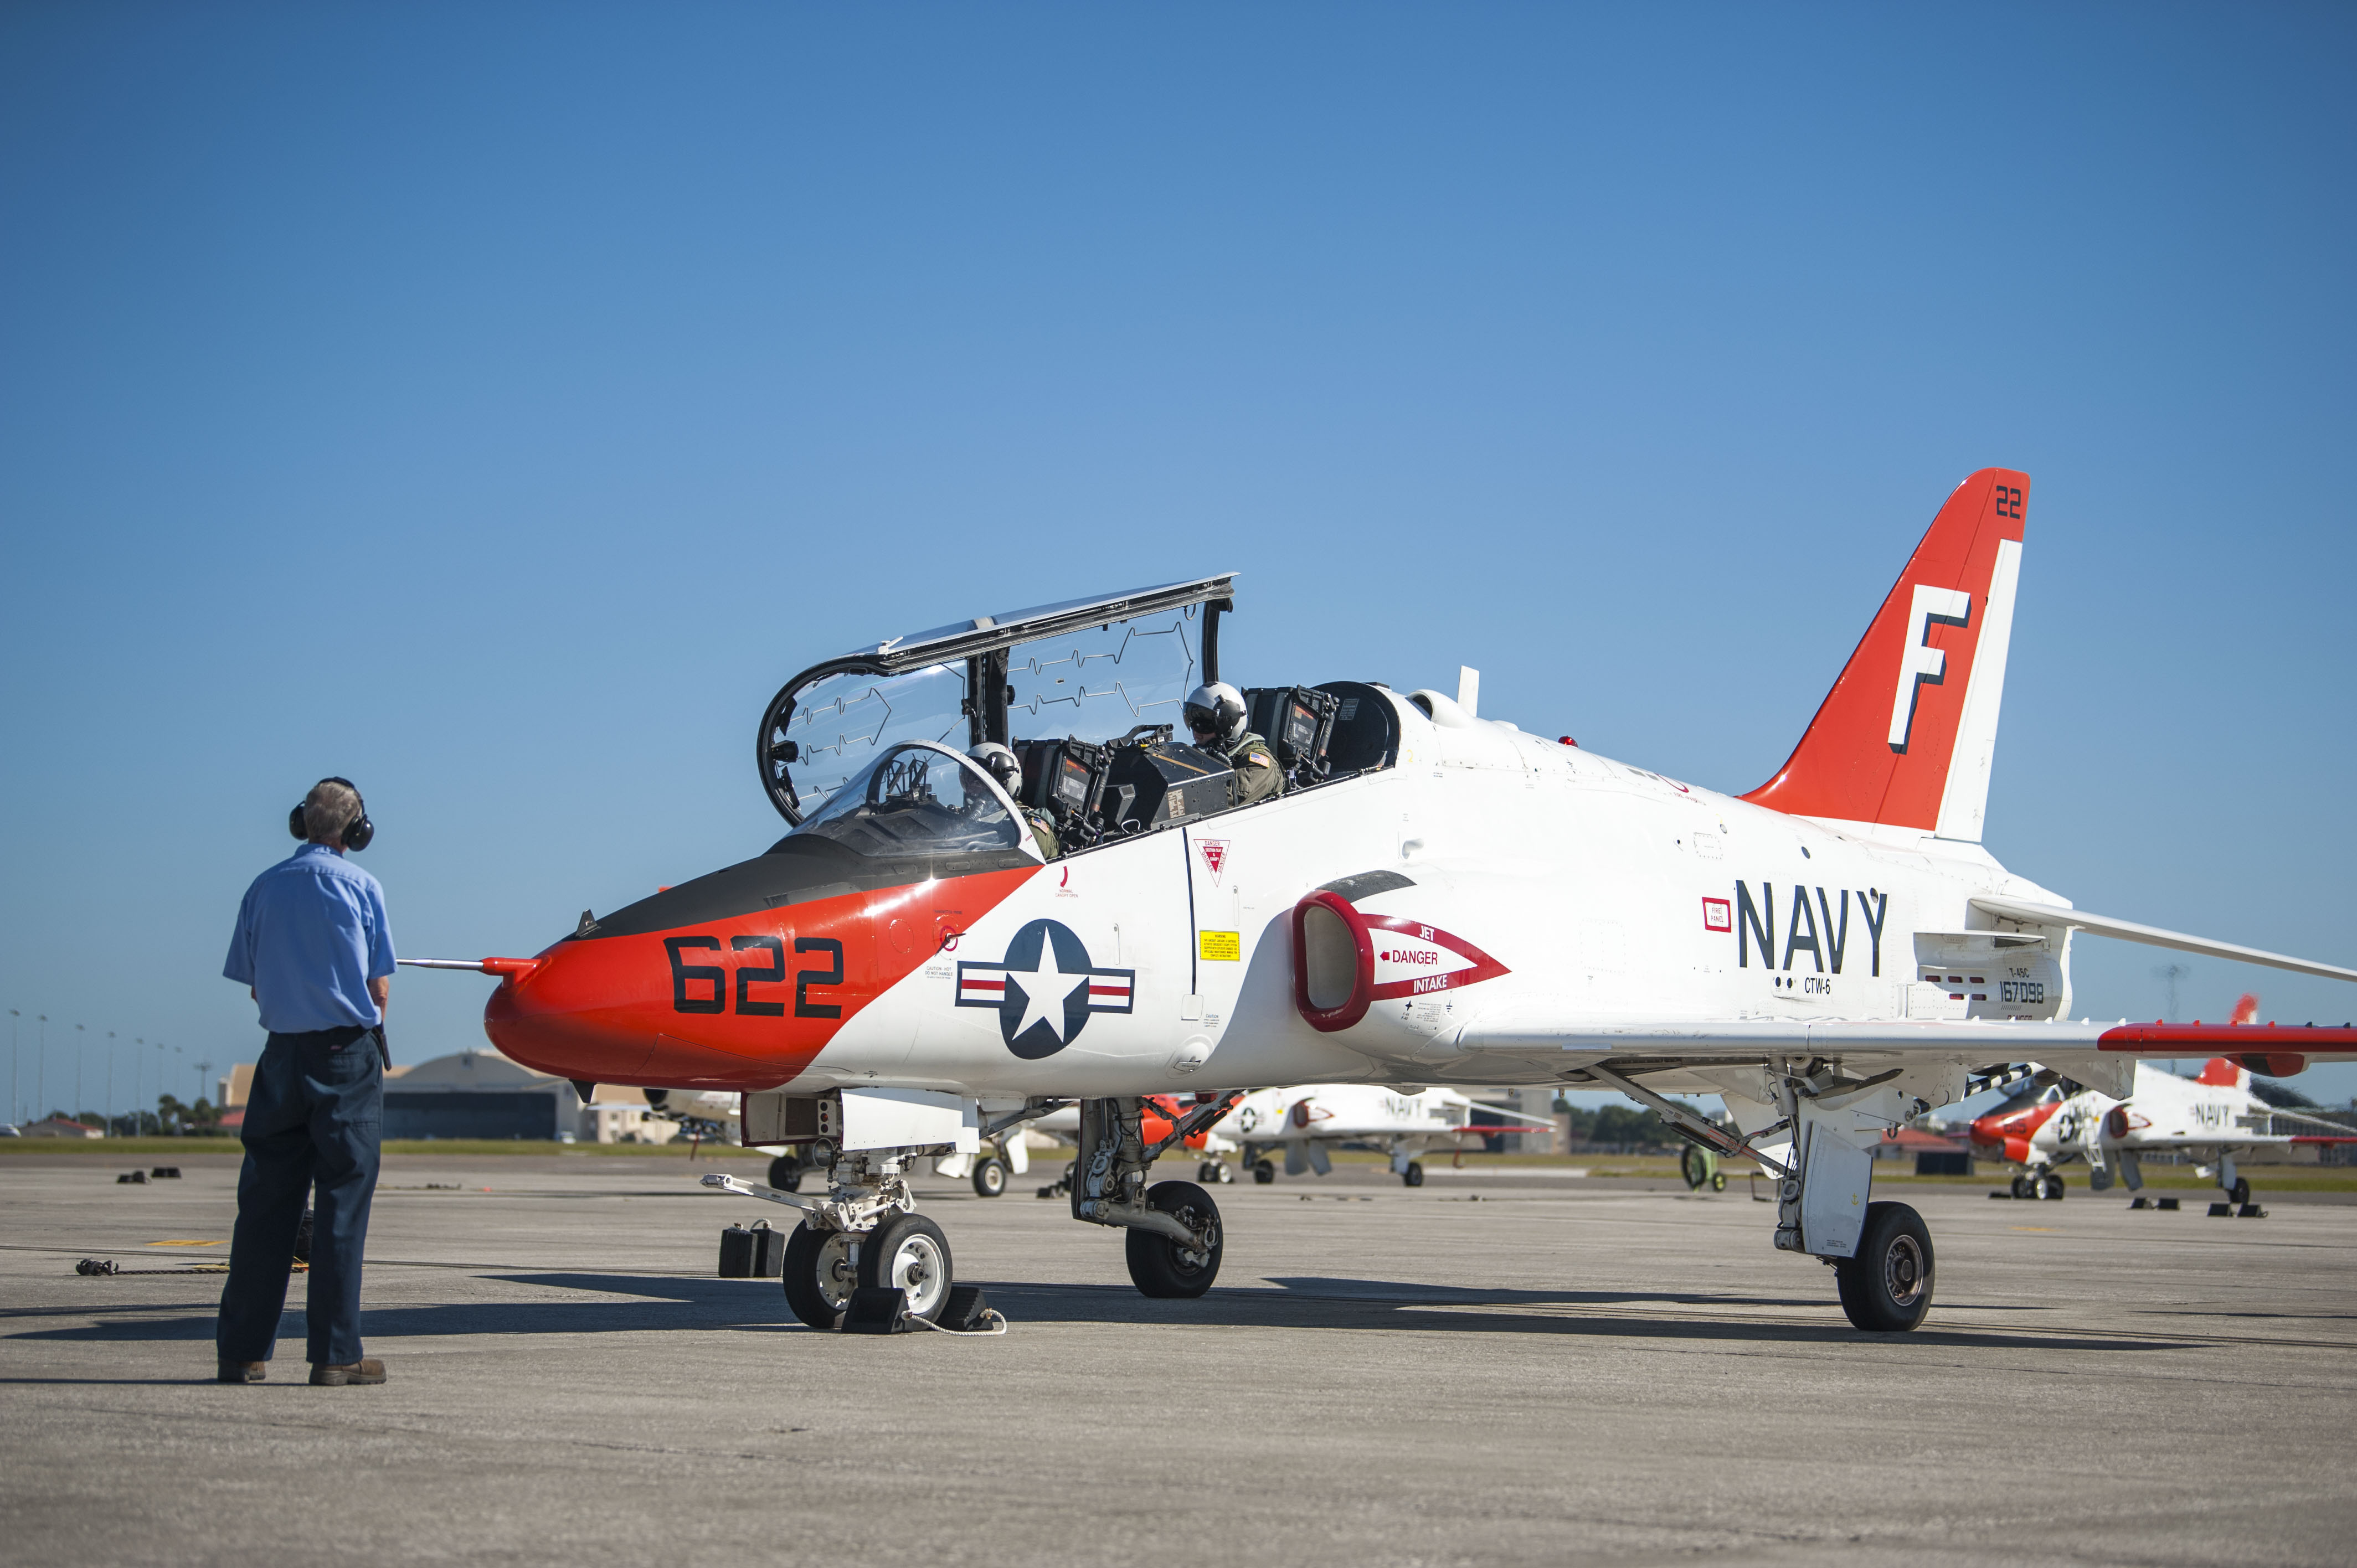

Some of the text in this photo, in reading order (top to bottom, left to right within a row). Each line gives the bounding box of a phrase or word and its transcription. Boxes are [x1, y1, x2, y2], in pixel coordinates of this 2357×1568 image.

[1996, 485, 2021, 519] 22
[1888, 584, 1972, 755] F
[1202, 851, 1213, 872] DANGER
[1218, 852, 1226, 873] DANGER
[1419, 925, 1434, 941] JET
[1736, 879, 1887, 977] NAVY
[1393, 950, 1438, 964] DANGER
[663, 935, 844, 1019] 622
[2009, 967, 2029, 978] T-45C
[1414, 974, 1447, 993] INTAKE
[1805, 977, 1830, 994] CTW-6
[1999, 981, 2044, 1004] 167098
[1386, 1097, 1422, 1117] NAVY
[2195, 1103, 2230, 1127] NAVY
